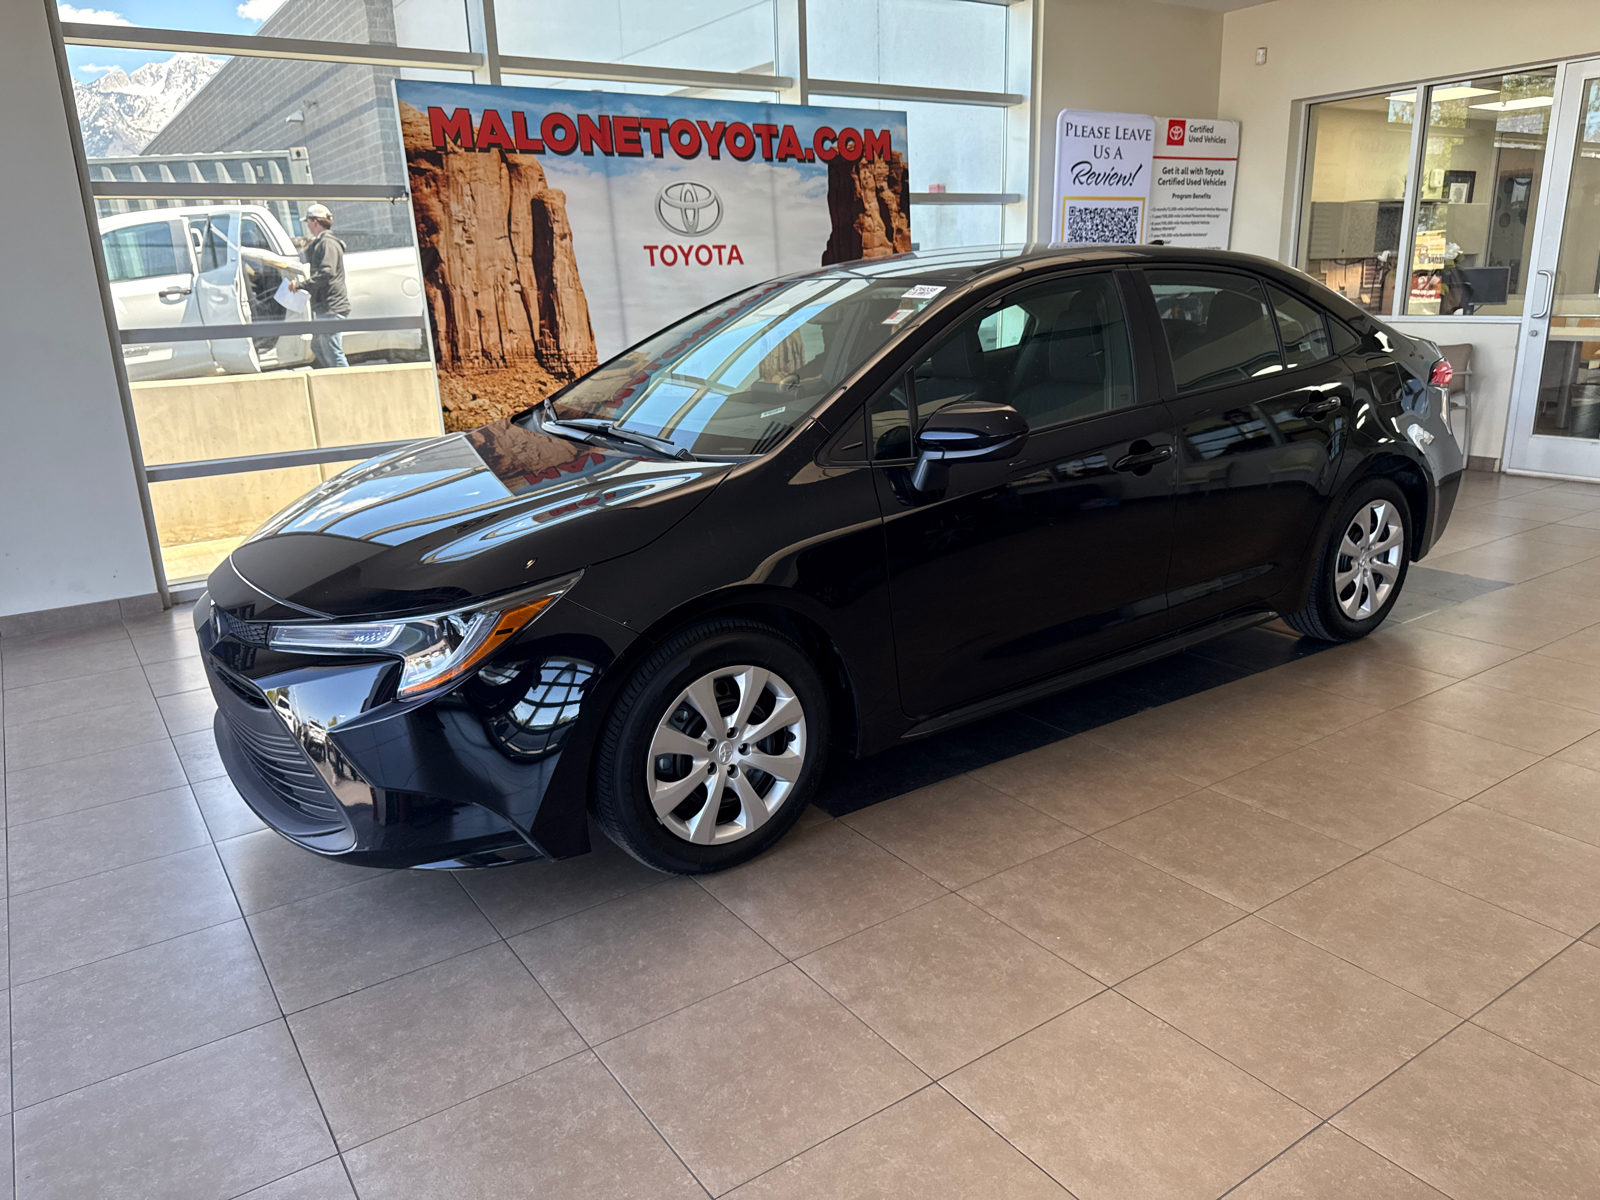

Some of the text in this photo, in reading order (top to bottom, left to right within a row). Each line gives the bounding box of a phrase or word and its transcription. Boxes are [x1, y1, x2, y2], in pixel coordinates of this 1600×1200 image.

[428, 106, 892, 163] MALONETOYOTA.COM
[1065, 122, 1152, 141] PLEASE LEAVE
[1189, 125, 1214, 134] Certified
[1188, 135, 1227, 144] Used Vehicles
[1093, 145, 1123, 160] US A
[1070, 161, 1143, 186] Review!
[1162, 166, 1174, 175] Get
[1175, 166, 1180, 175] it
[1180, 167, 1189, 175] all
[1205, 167, 1225, 177] Toyota
[1157, 178, 1227, 187] Certified Used Vehicles
[642, 243, 745, 268] TOYOTA
